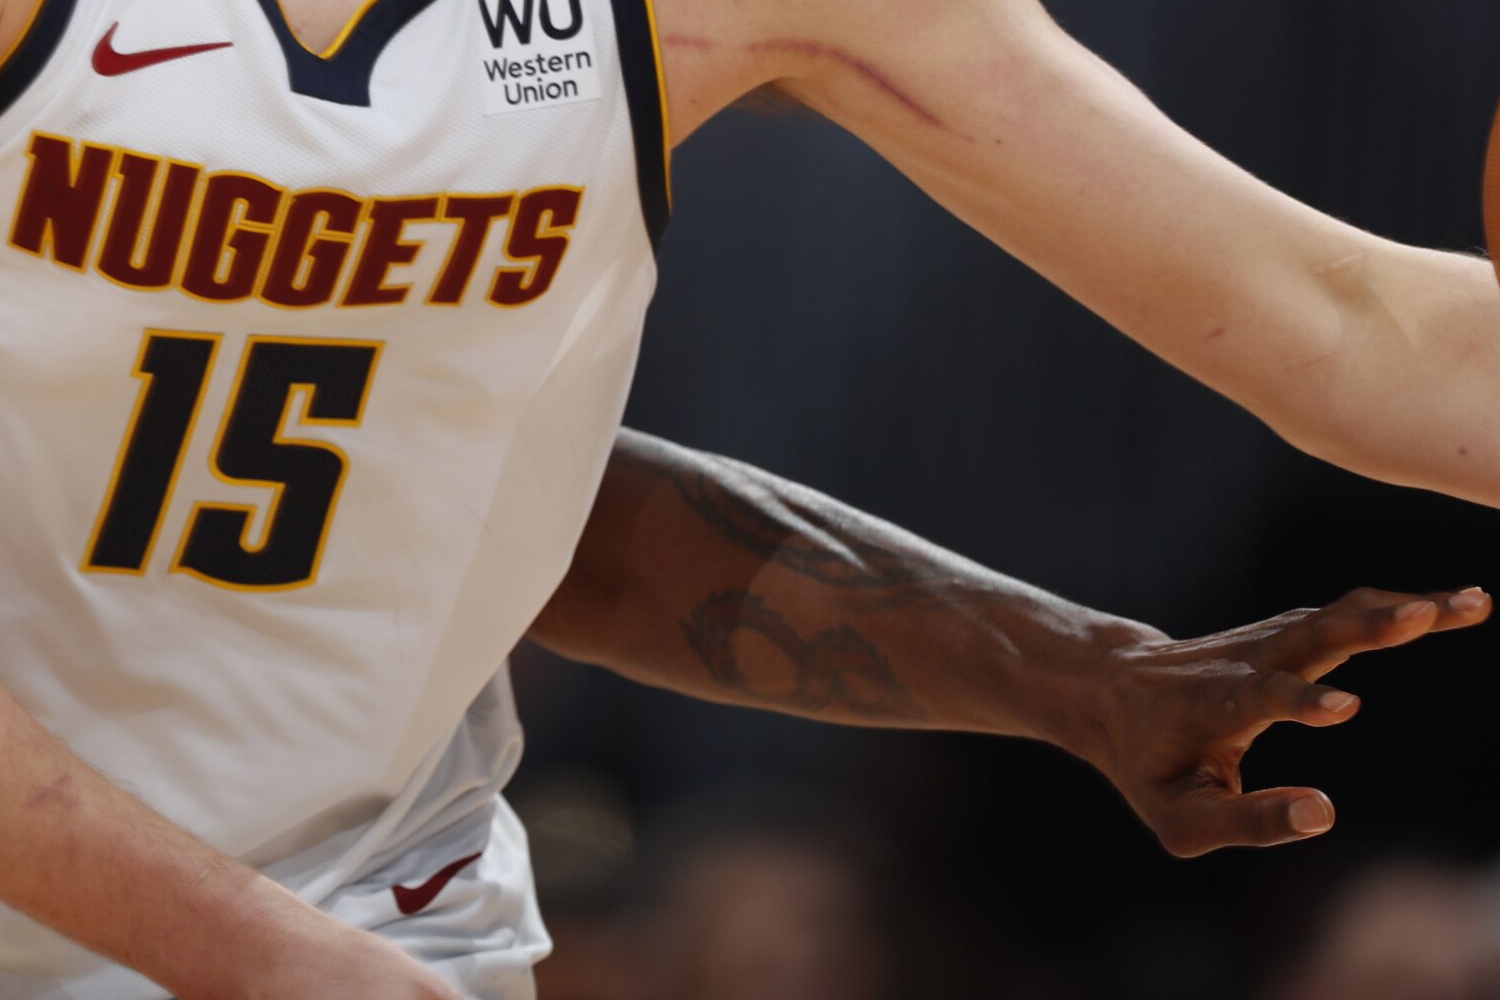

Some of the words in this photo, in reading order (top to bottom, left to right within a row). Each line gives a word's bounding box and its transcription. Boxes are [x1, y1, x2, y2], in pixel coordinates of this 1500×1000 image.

[483, 51, 592, 82] Western
[504, 77, 579, 106] Union
[6, 129, 586, 310] NUGGETS
[80, 328, 386, 594] 15
